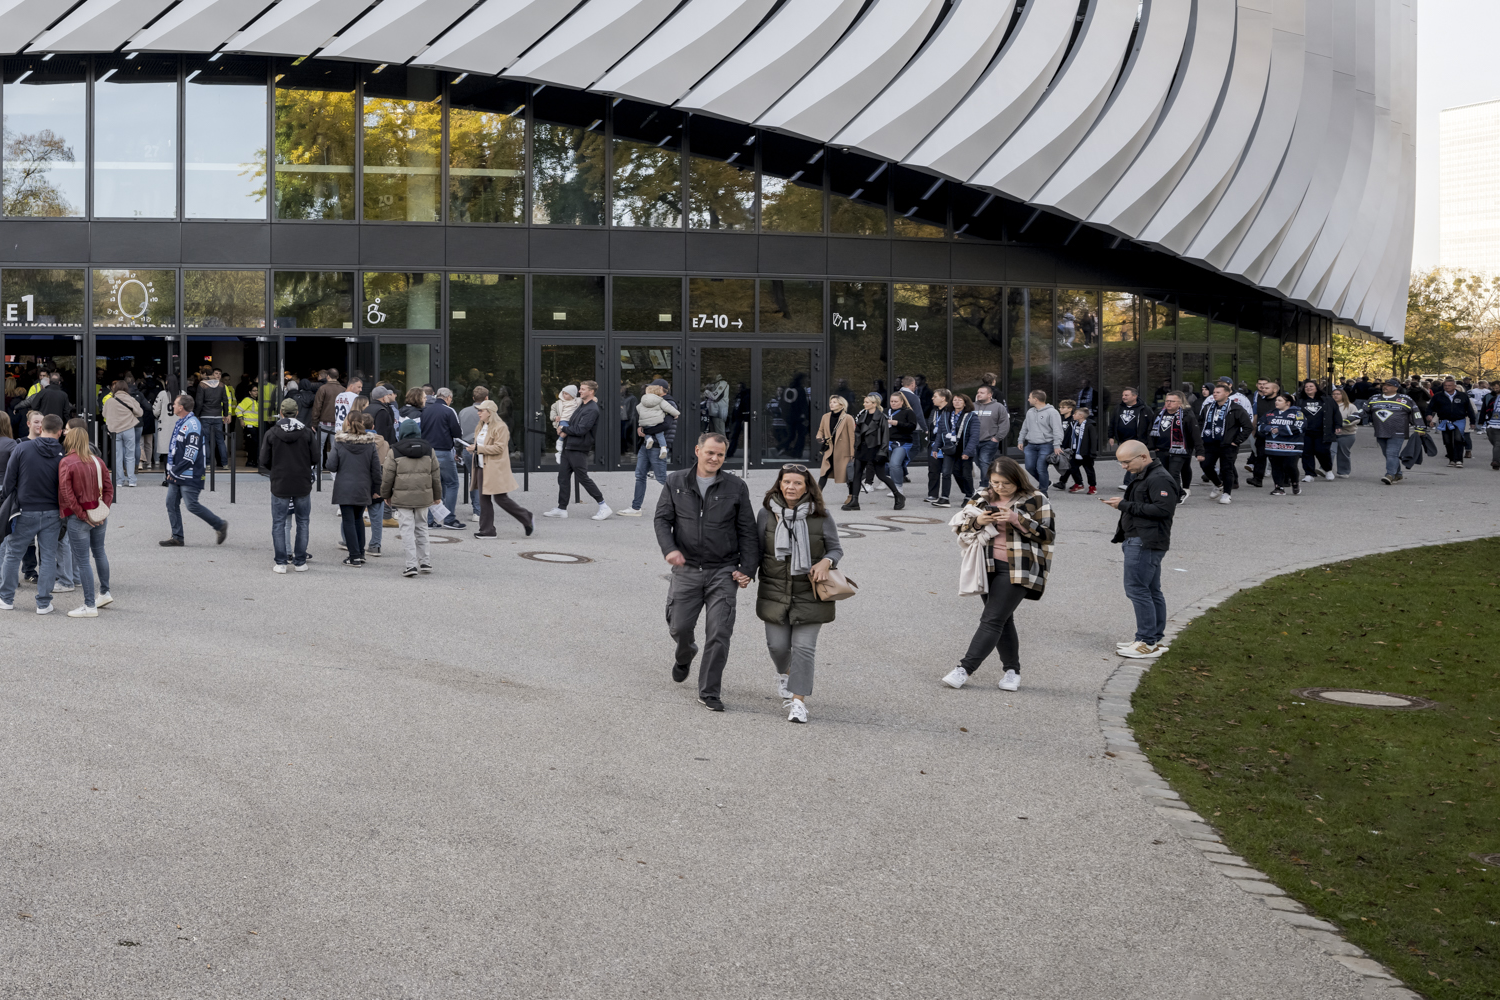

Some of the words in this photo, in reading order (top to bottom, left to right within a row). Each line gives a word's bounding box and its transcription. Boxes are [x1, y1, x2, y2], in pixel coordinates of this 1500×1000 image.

[6, 294, 34, 321] E1
[692, 314, 729, 328] E7-10
[842, 317, 854, 331] T1
